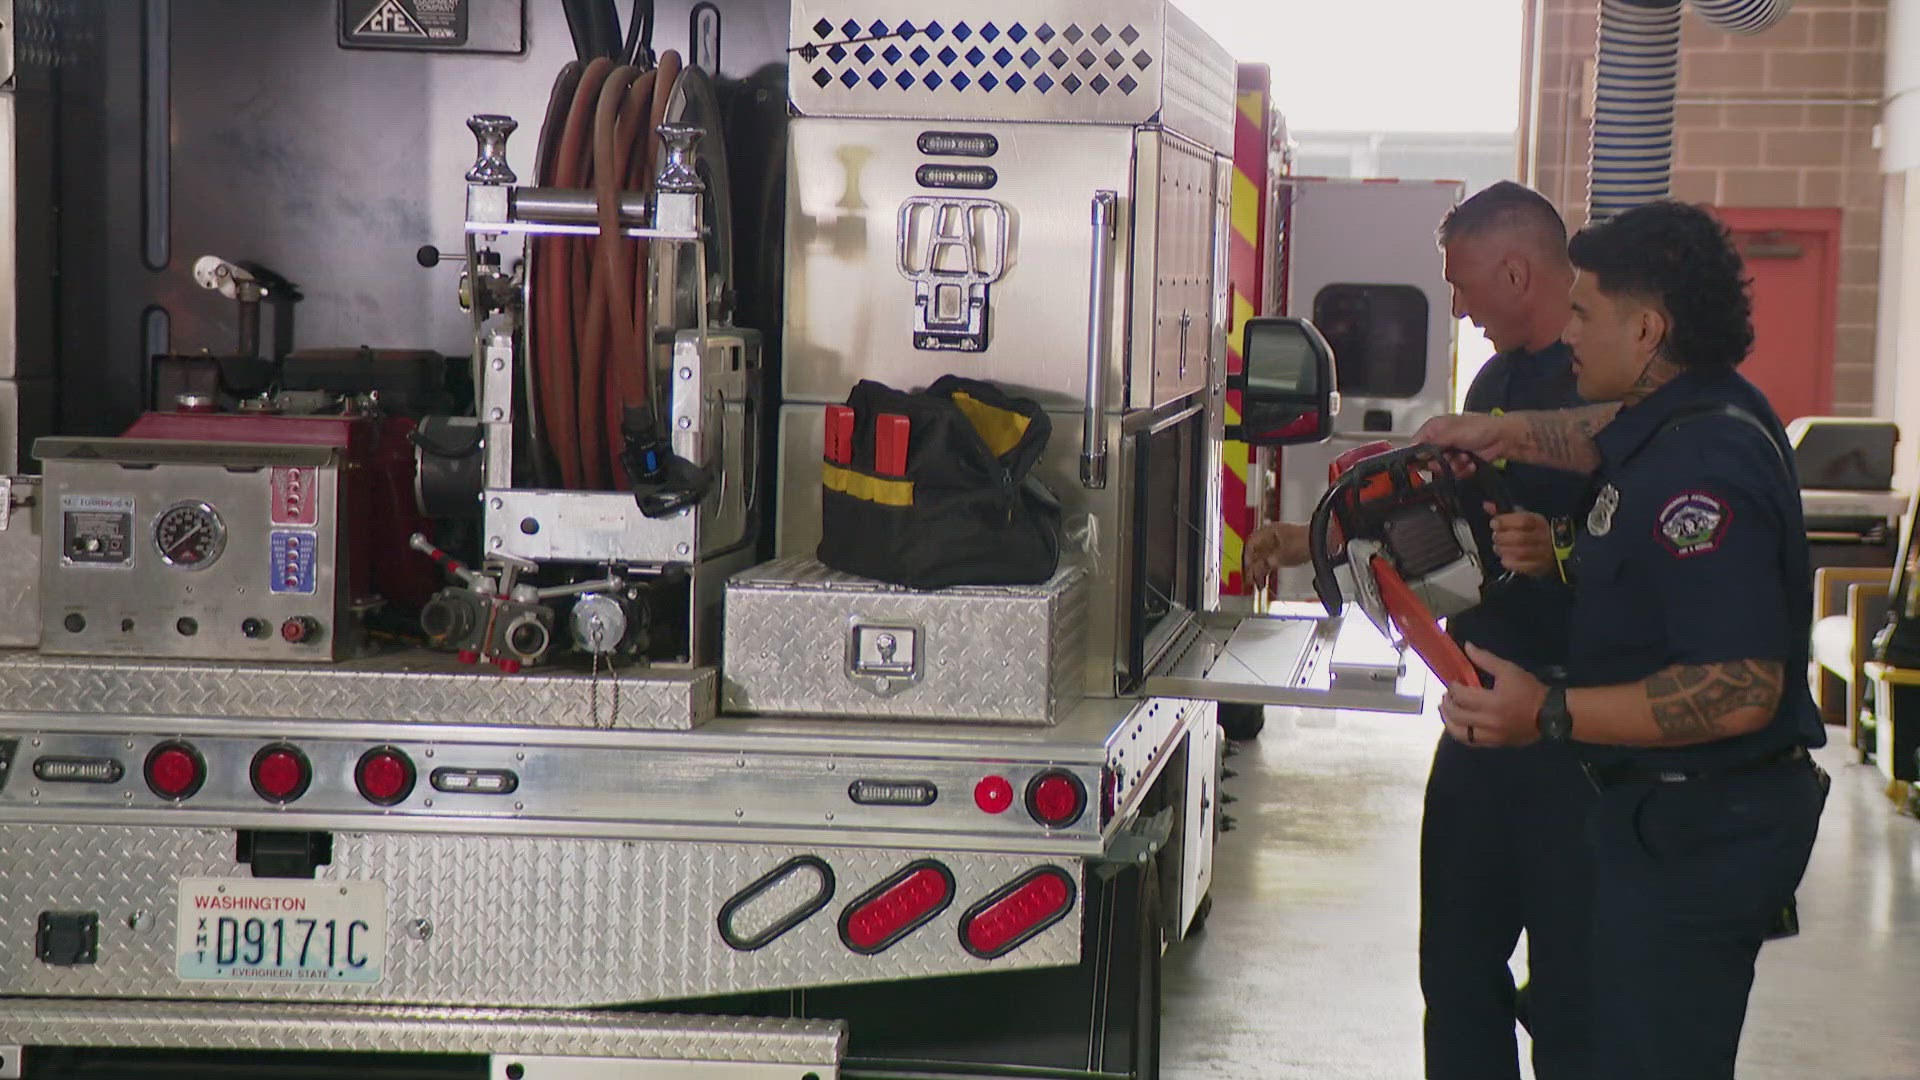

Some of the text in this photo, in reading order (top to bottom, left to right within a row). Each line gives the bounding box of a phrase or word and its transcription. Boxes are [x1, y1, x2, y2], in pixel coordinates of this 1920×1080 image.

[416, 4, 455, 12] COMPANY
[195, 895, 306, 911] WASHINGTON
[216, 916, 369, 968] D9171C
[231, 968, 330, 979] EVERGREEN STATE
